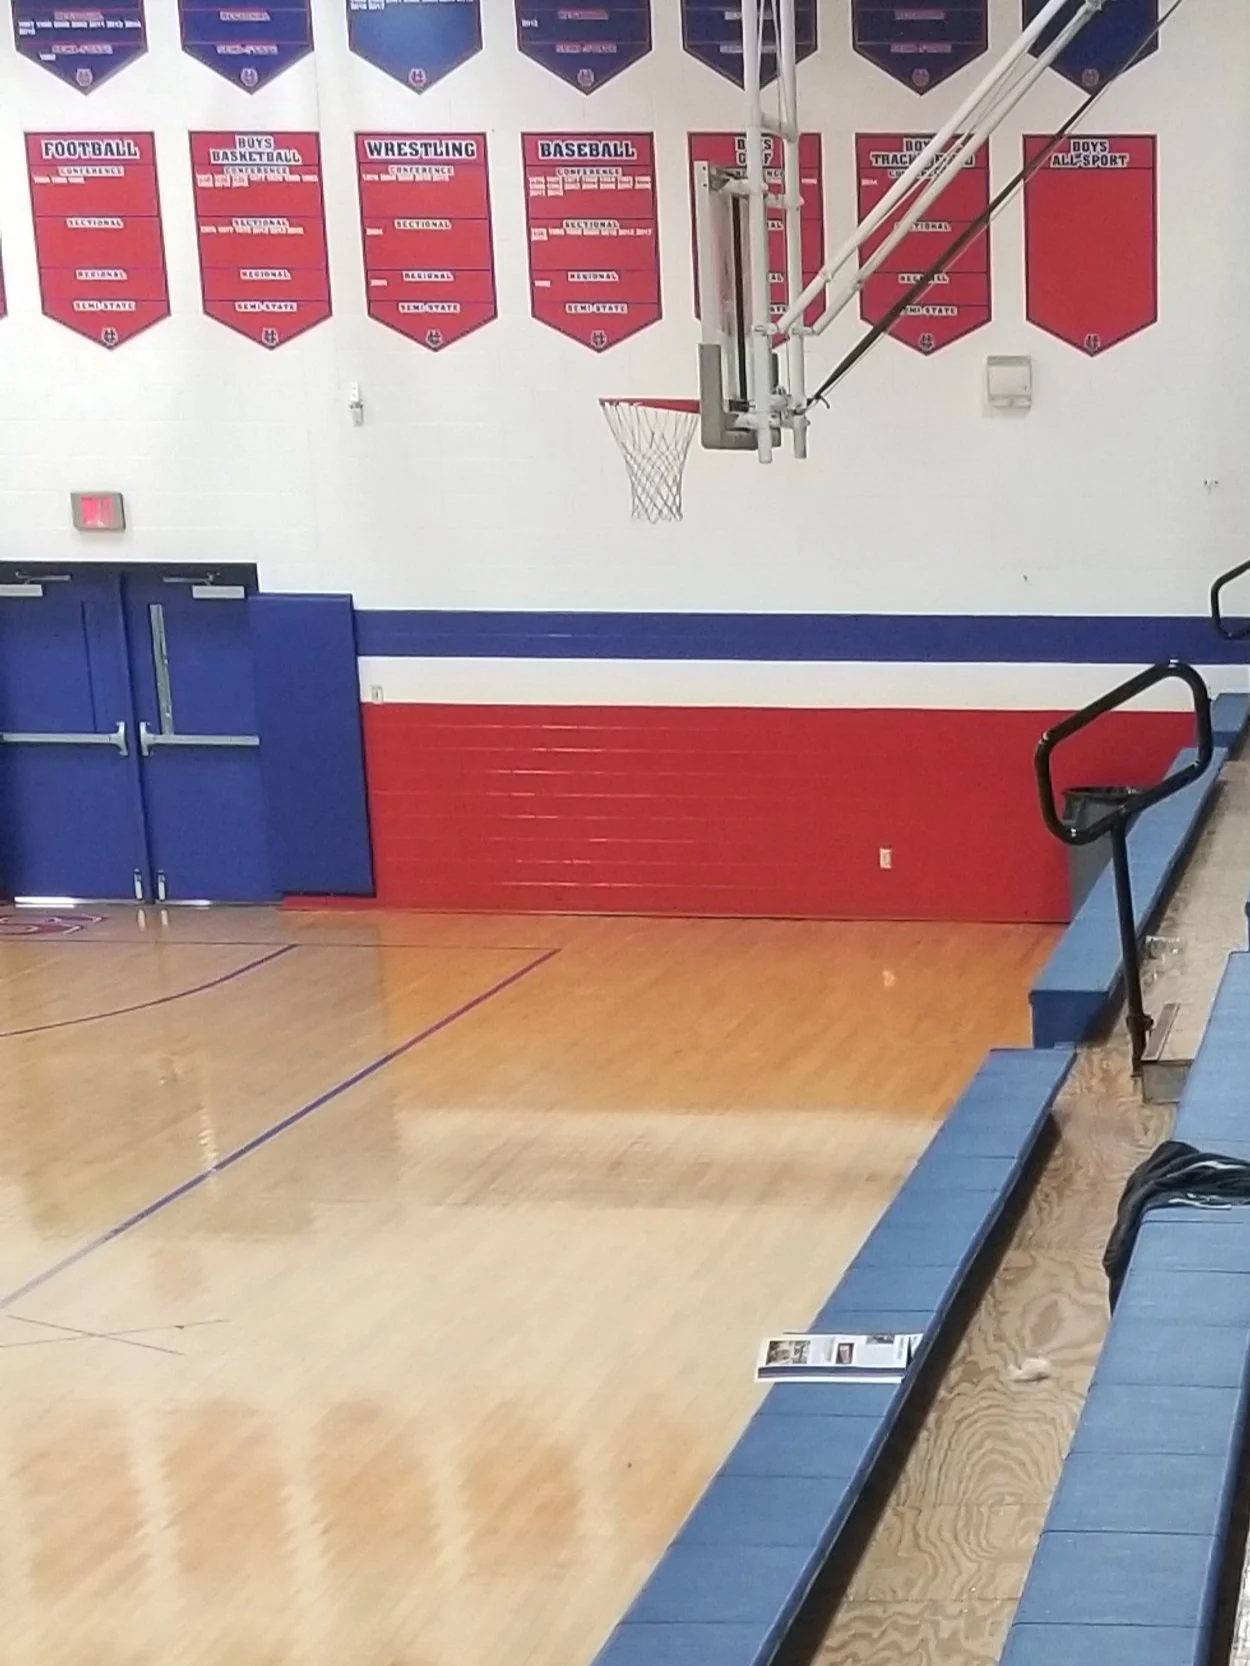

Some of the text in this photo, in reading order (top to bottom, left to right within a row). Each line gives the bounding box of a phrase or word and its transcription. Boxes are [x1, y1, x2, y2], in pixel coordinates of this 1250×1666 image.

[237, 137, 272, 149] BOYS
[736, 138, 772, 150] BS
[1072, 141, 1108, 152] BOYS
[43, 140, 139, 158] FOOTBALL
[366, 140, 475, 158] WRESTLING
[540, 142, 635, 158] BASEBALL
[211, 150, 301, 163] BASKETBALL
[389, 166, 453, 175] CONFERENCE
[557, 168, 621, 176] CONFERENCE
[395, 220, 451, 228] SECTIONAL
[564, 220, 618, 228] SECTIONAL
[403, 272, 453, 280] REGIONAL
[568, 272, 618, 280] REGIONAL
